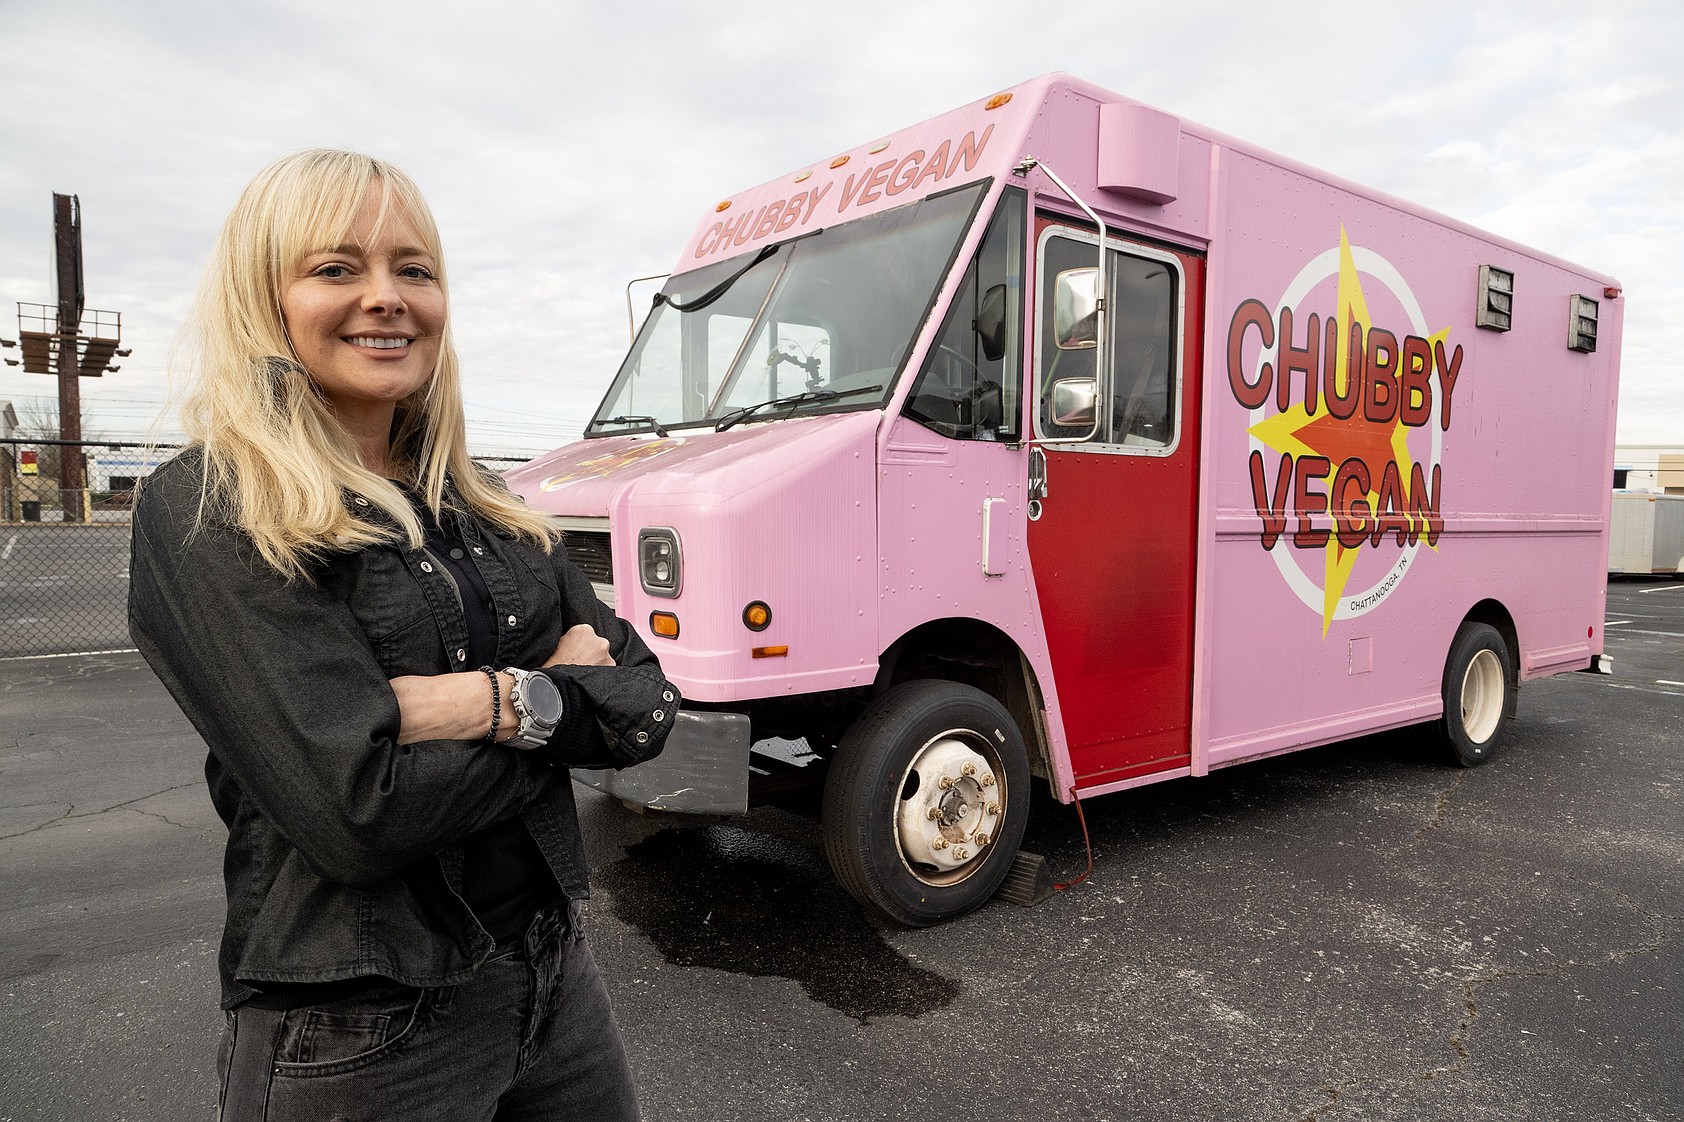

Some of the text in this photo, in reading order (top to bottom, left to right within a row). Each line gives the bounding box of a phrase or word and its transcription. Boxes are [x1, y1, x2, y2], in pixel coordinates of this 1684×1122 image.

[695, 123, 995, 259] CHUBBY VEGAN
[1227, 298, 1464, 432] CHUBBY
[1249, 449, 1445, 551] VEGAN
[1398, 556, 1408, 571] TN
